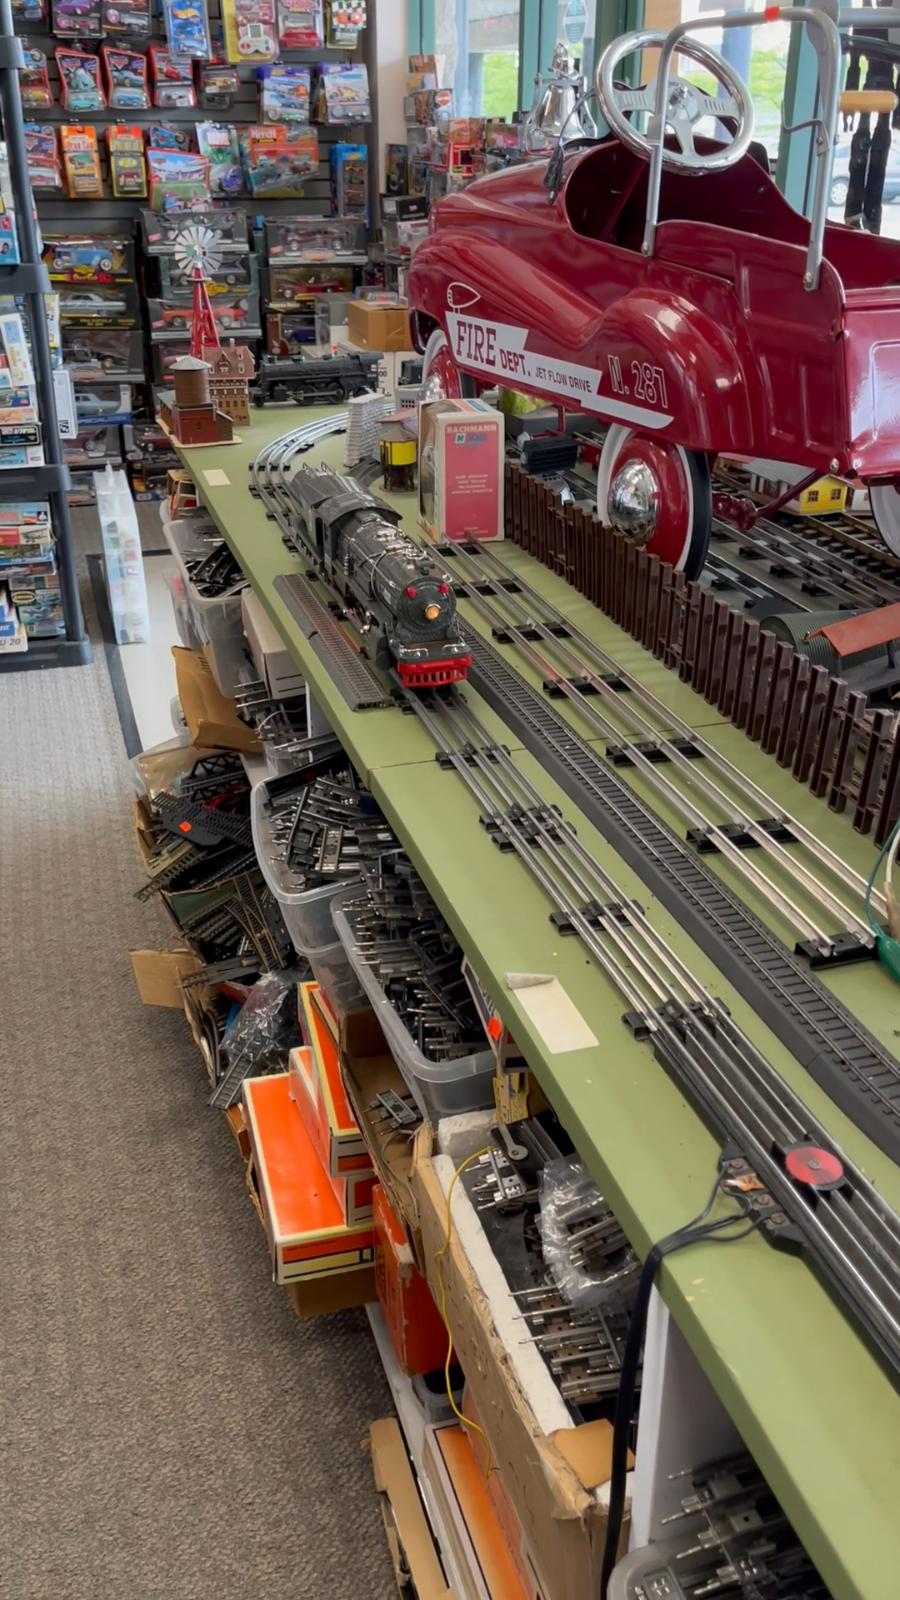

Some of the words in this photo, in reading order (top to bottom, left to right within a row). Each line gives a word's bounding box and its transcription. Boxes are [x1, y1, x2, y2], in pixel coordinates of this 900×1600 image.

[456, 320, 496, 367] FIRE
[499, 348, 531, 377] DEPT.
[535, 366, 547, 379] JET
[549, 370, 567, 385] FLOW
[568, 375, 592, 393] DRIVE
[607, 354, 630, 395] N.
[630, 360, 668, 409] 287
[446, 424, 497, 433] BACHMANN
[456, 434, 464, 442] N
[9, 638, 21, 646] 20
